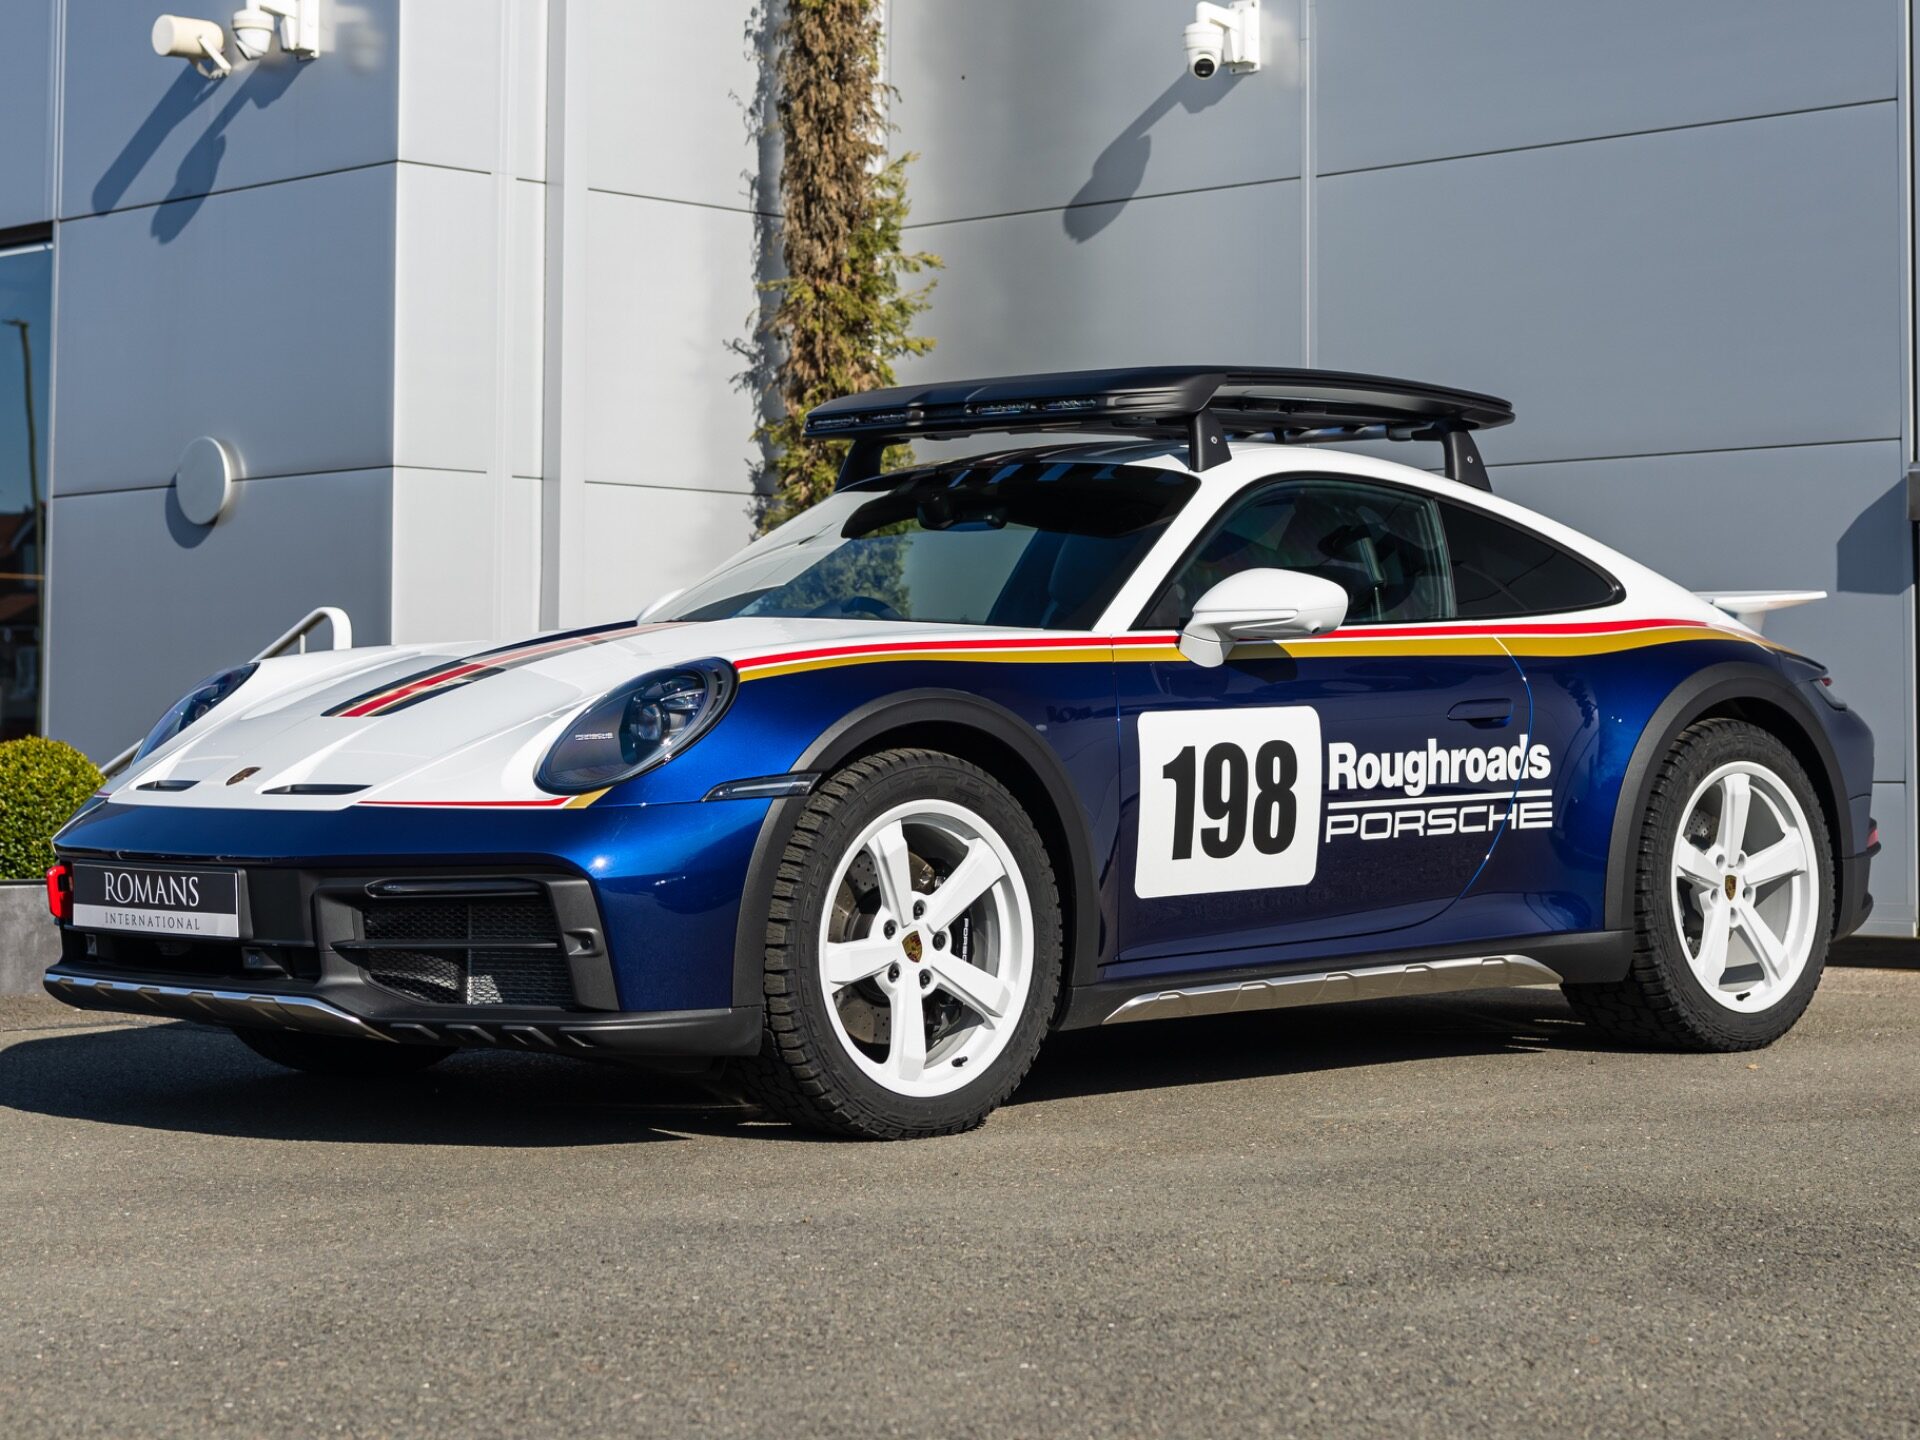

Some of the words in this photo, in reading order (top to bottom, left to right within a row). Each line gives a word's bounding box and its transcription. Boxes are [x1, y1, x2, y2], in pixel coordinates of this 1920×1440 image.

[1328, 733, 1552, 797] Roughroads
[1162, 739, 1299, 861] 198
[1325, 801, 1553, 843] PORSCHE
[104, 871, 200, 907] ROMANS
[104, 911, 200, 931] INTERNATIONAL
